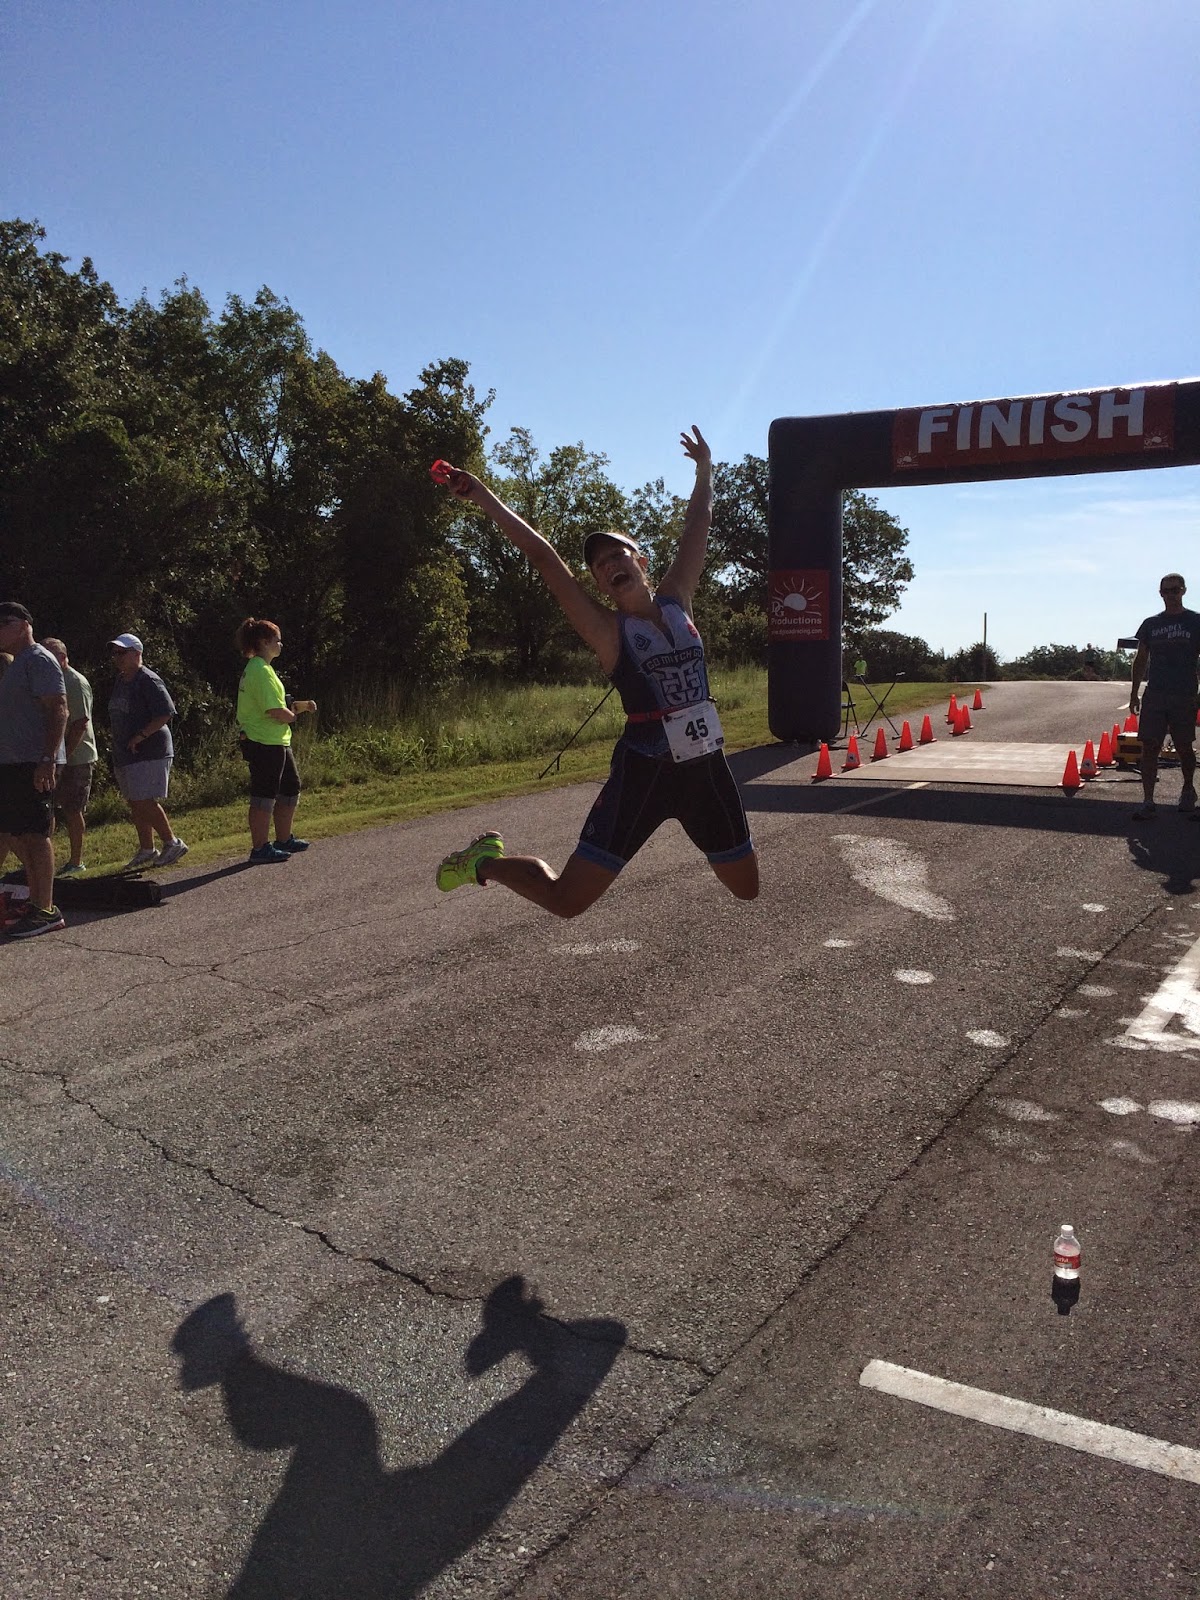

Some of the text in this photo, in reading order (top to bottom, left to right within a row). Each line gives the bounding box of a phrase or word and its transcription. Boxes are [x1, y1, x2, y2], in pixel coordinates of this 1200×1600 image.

[917, 389, 1146, 454] FINISH
[771, 616, 822, 625] Productions
[646, 648, 702, 670] GO MITCH GO
[685, 717, 709, 741] 45
